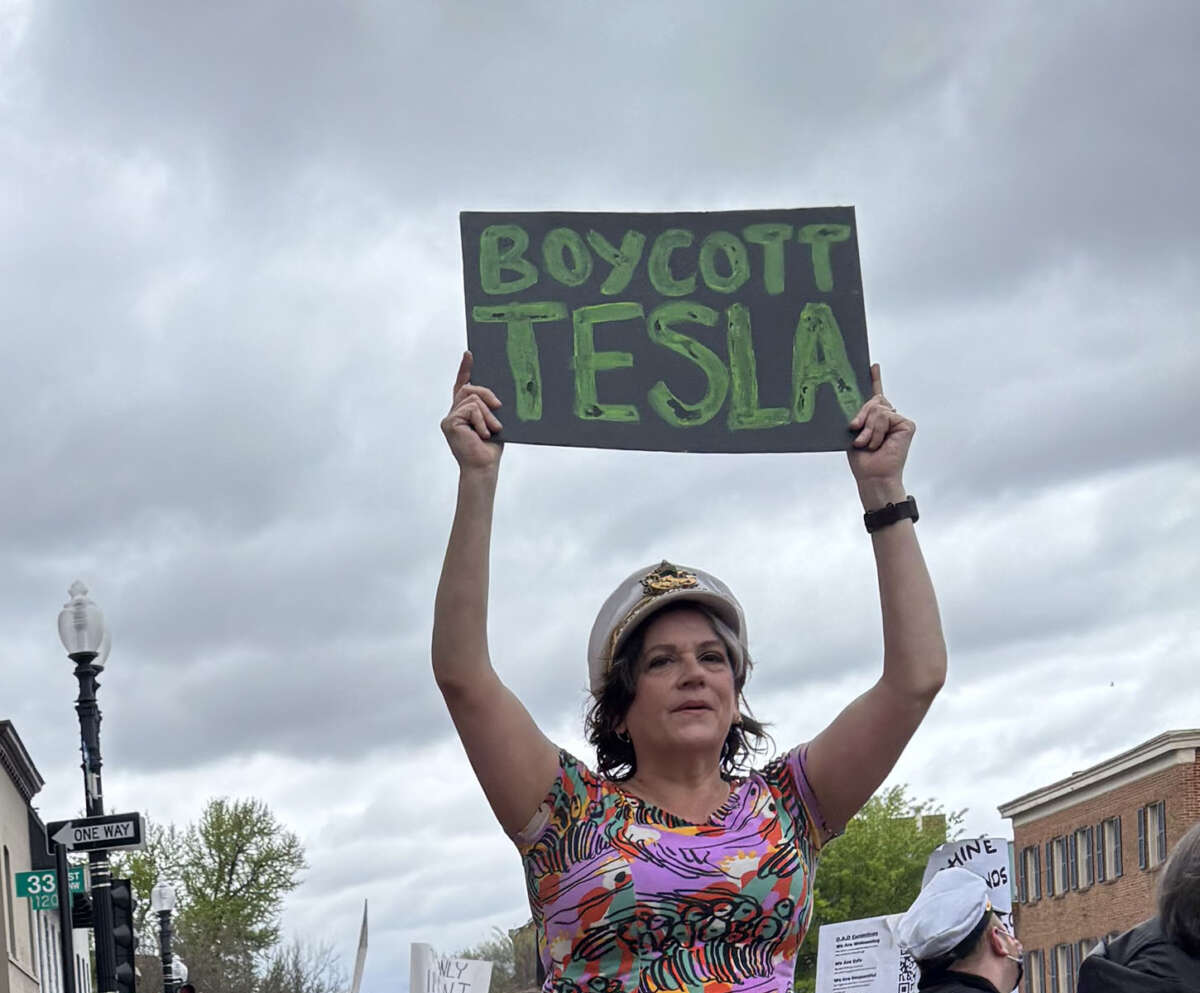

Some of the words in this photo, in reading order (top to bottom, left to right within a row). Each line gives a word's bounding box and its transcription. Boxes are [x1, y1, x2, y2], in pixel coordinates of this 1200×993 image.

[479, 223, 851, 296] BOYCOTT
[472, 302, 865, 430] TESLA
[74, 828, 100, 842] ONE
[103, 823, 130, 838] WAY
